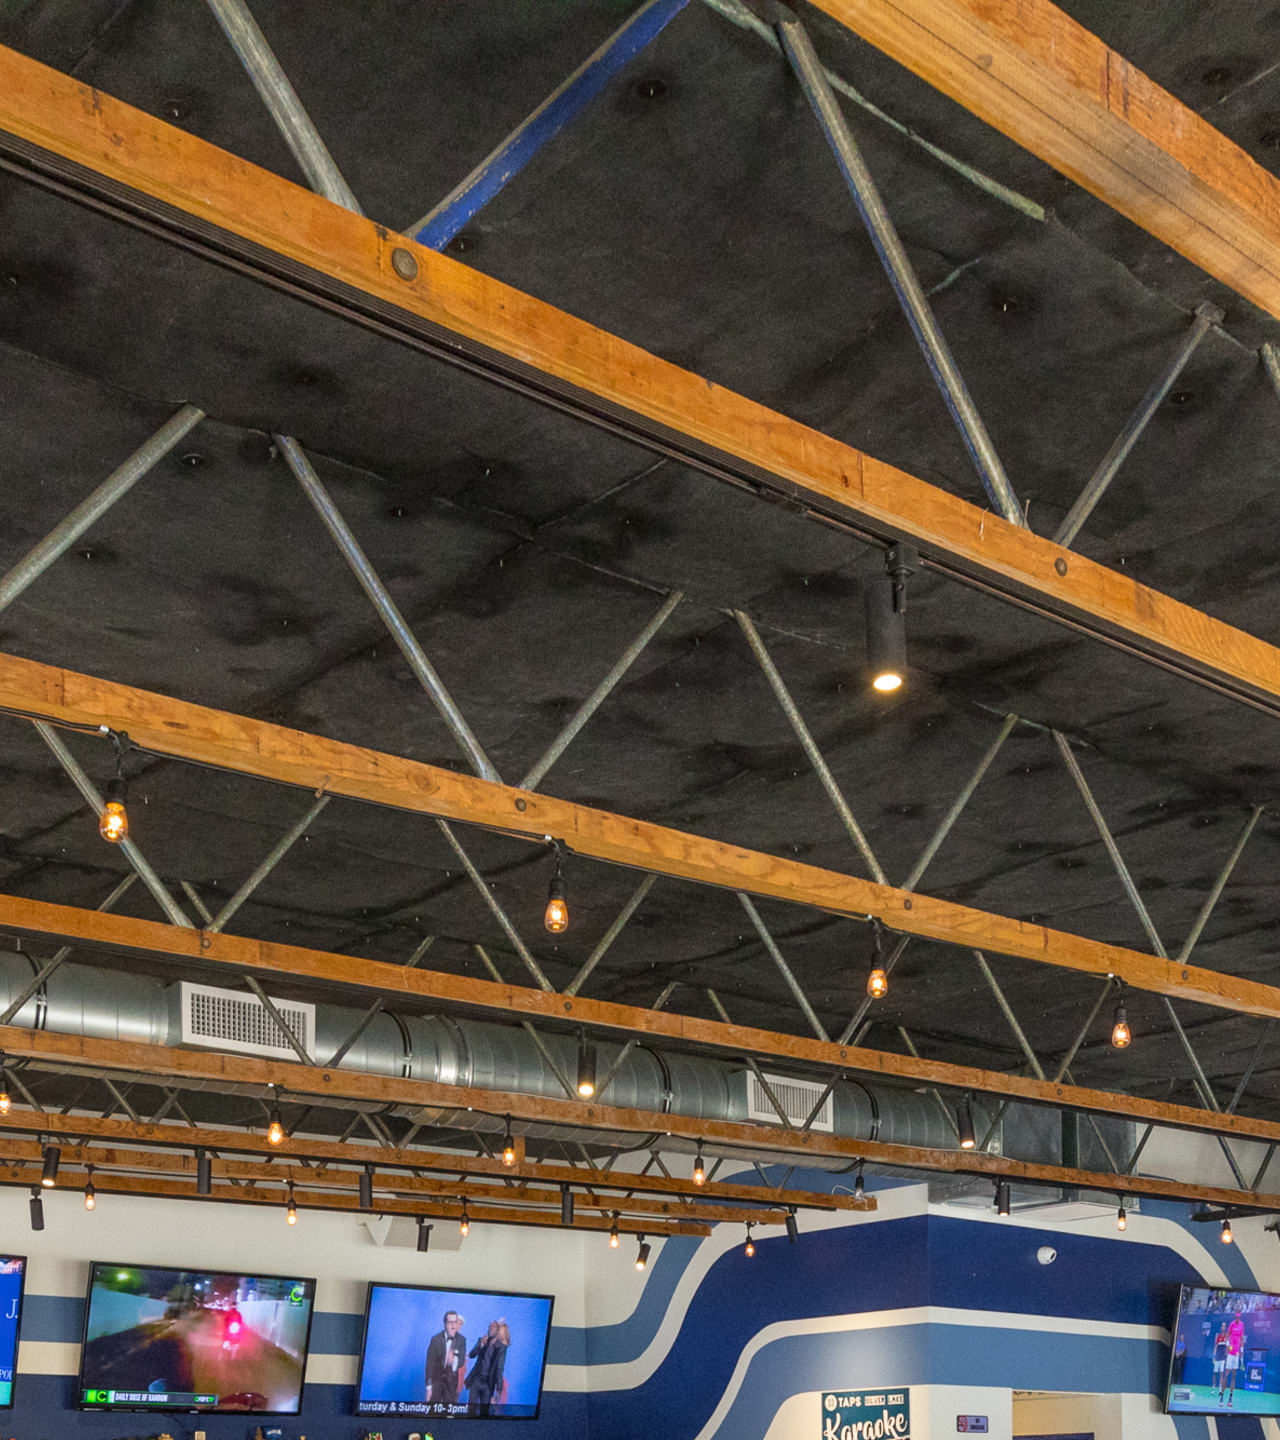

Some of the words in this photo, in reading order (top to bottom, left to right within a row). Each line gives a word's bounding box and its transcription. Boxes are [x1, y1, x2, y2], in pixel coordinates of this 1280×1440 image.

[115, 1392, 128, 1401] DAILY
[148, 1394, 168, 1402] RANDOM
[838, 1396, 862, 1408] TAPS
[359, 1402, 388, 1413] turday
[389, 1402, 397, 1412] &
[398, 1402, 431, 1414] Sunday
[447, 1404, 469, 1414] 3pm!
